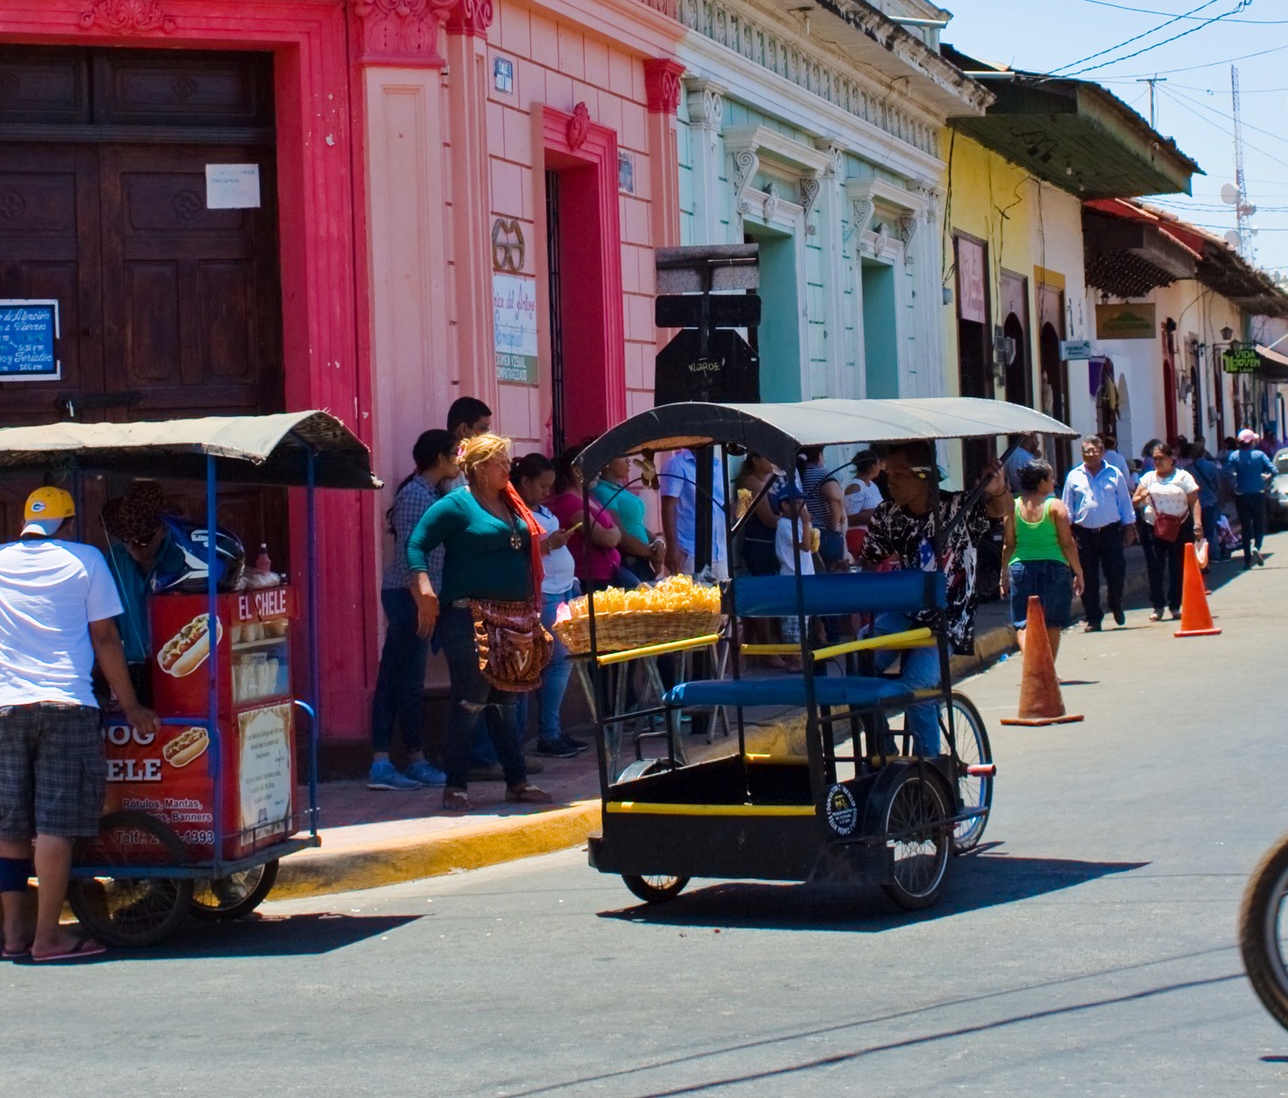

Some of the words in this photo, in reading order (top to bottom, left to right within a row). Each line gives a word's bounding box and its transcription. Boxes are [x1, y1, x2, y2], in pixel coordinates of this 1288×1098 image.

[239, 595, 253, 621] EL
[255, 589, 287, 617] CHELE
[101, 724, 155, 745] OG
[106, 759, 162, 781] ELE
[123, 798, 164, 810] Rótulos,
[164, 798, 203, 810] Mantas,
[172, 811, 213, 823] Banners
